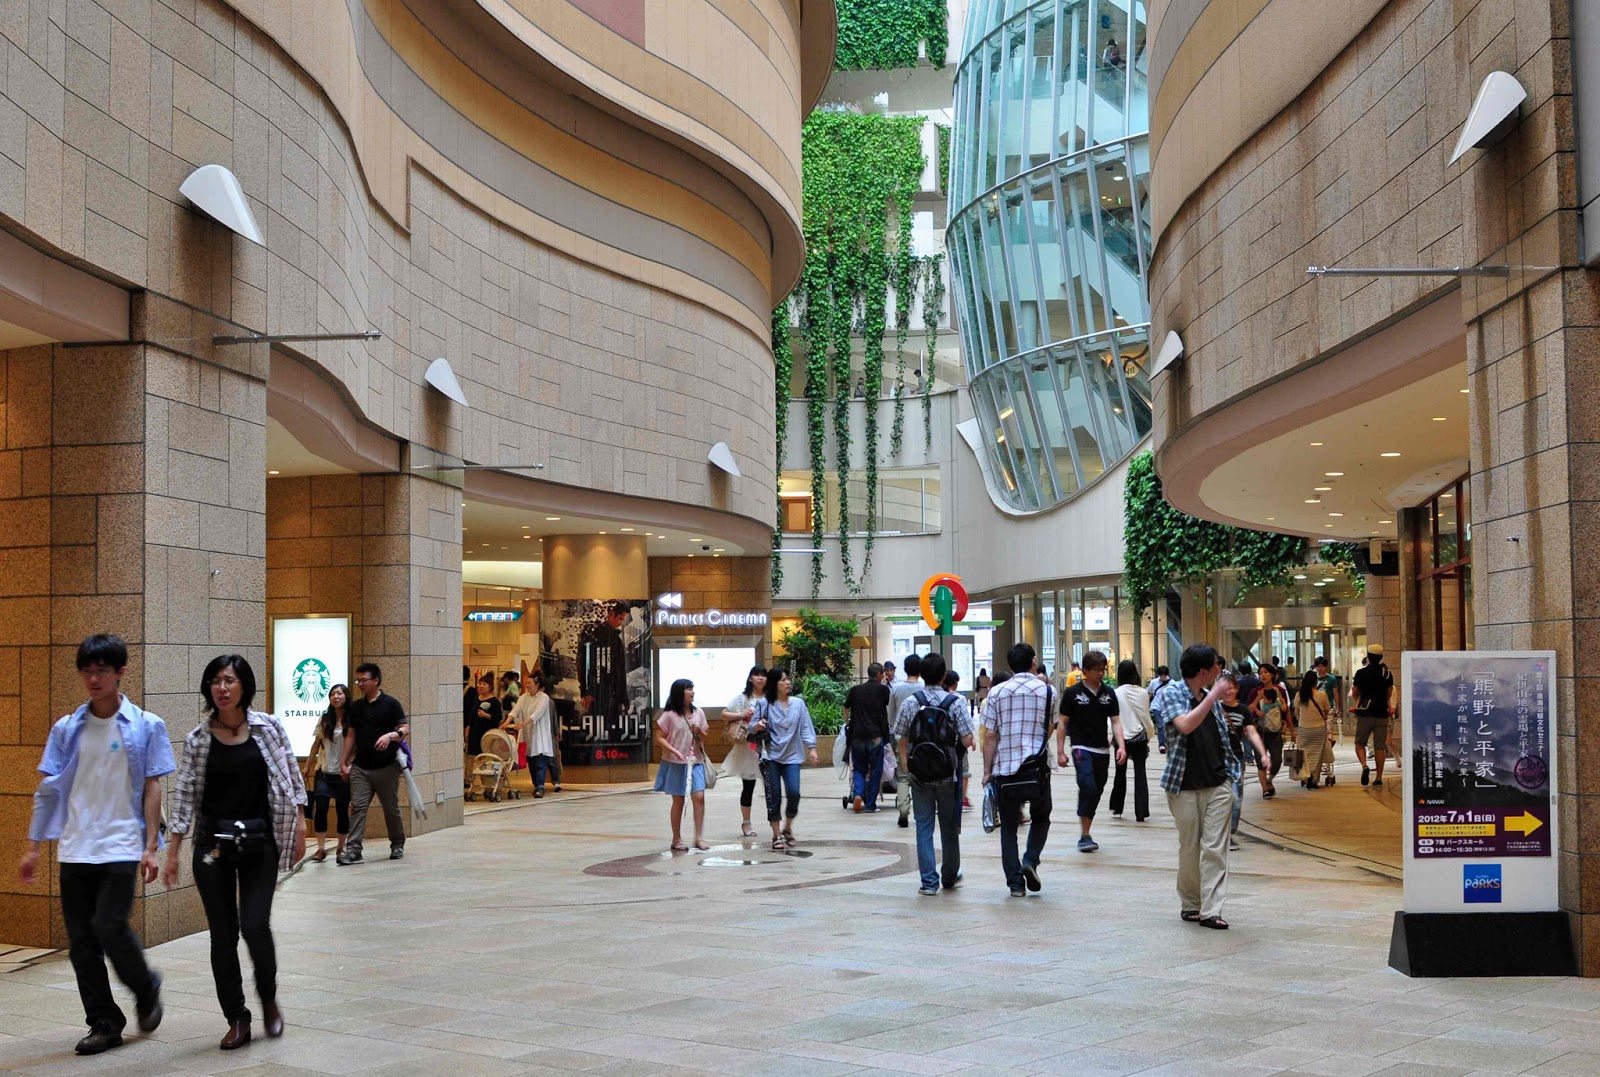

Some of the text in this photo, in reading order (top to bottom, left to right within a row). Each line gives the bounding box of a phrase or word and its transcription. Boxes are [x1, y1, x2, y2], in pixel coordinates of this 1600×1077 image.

[658, 610, 767, 625] PARKS CINEMA
[1473, 671, 1497, 788] 「熊野と平家」
